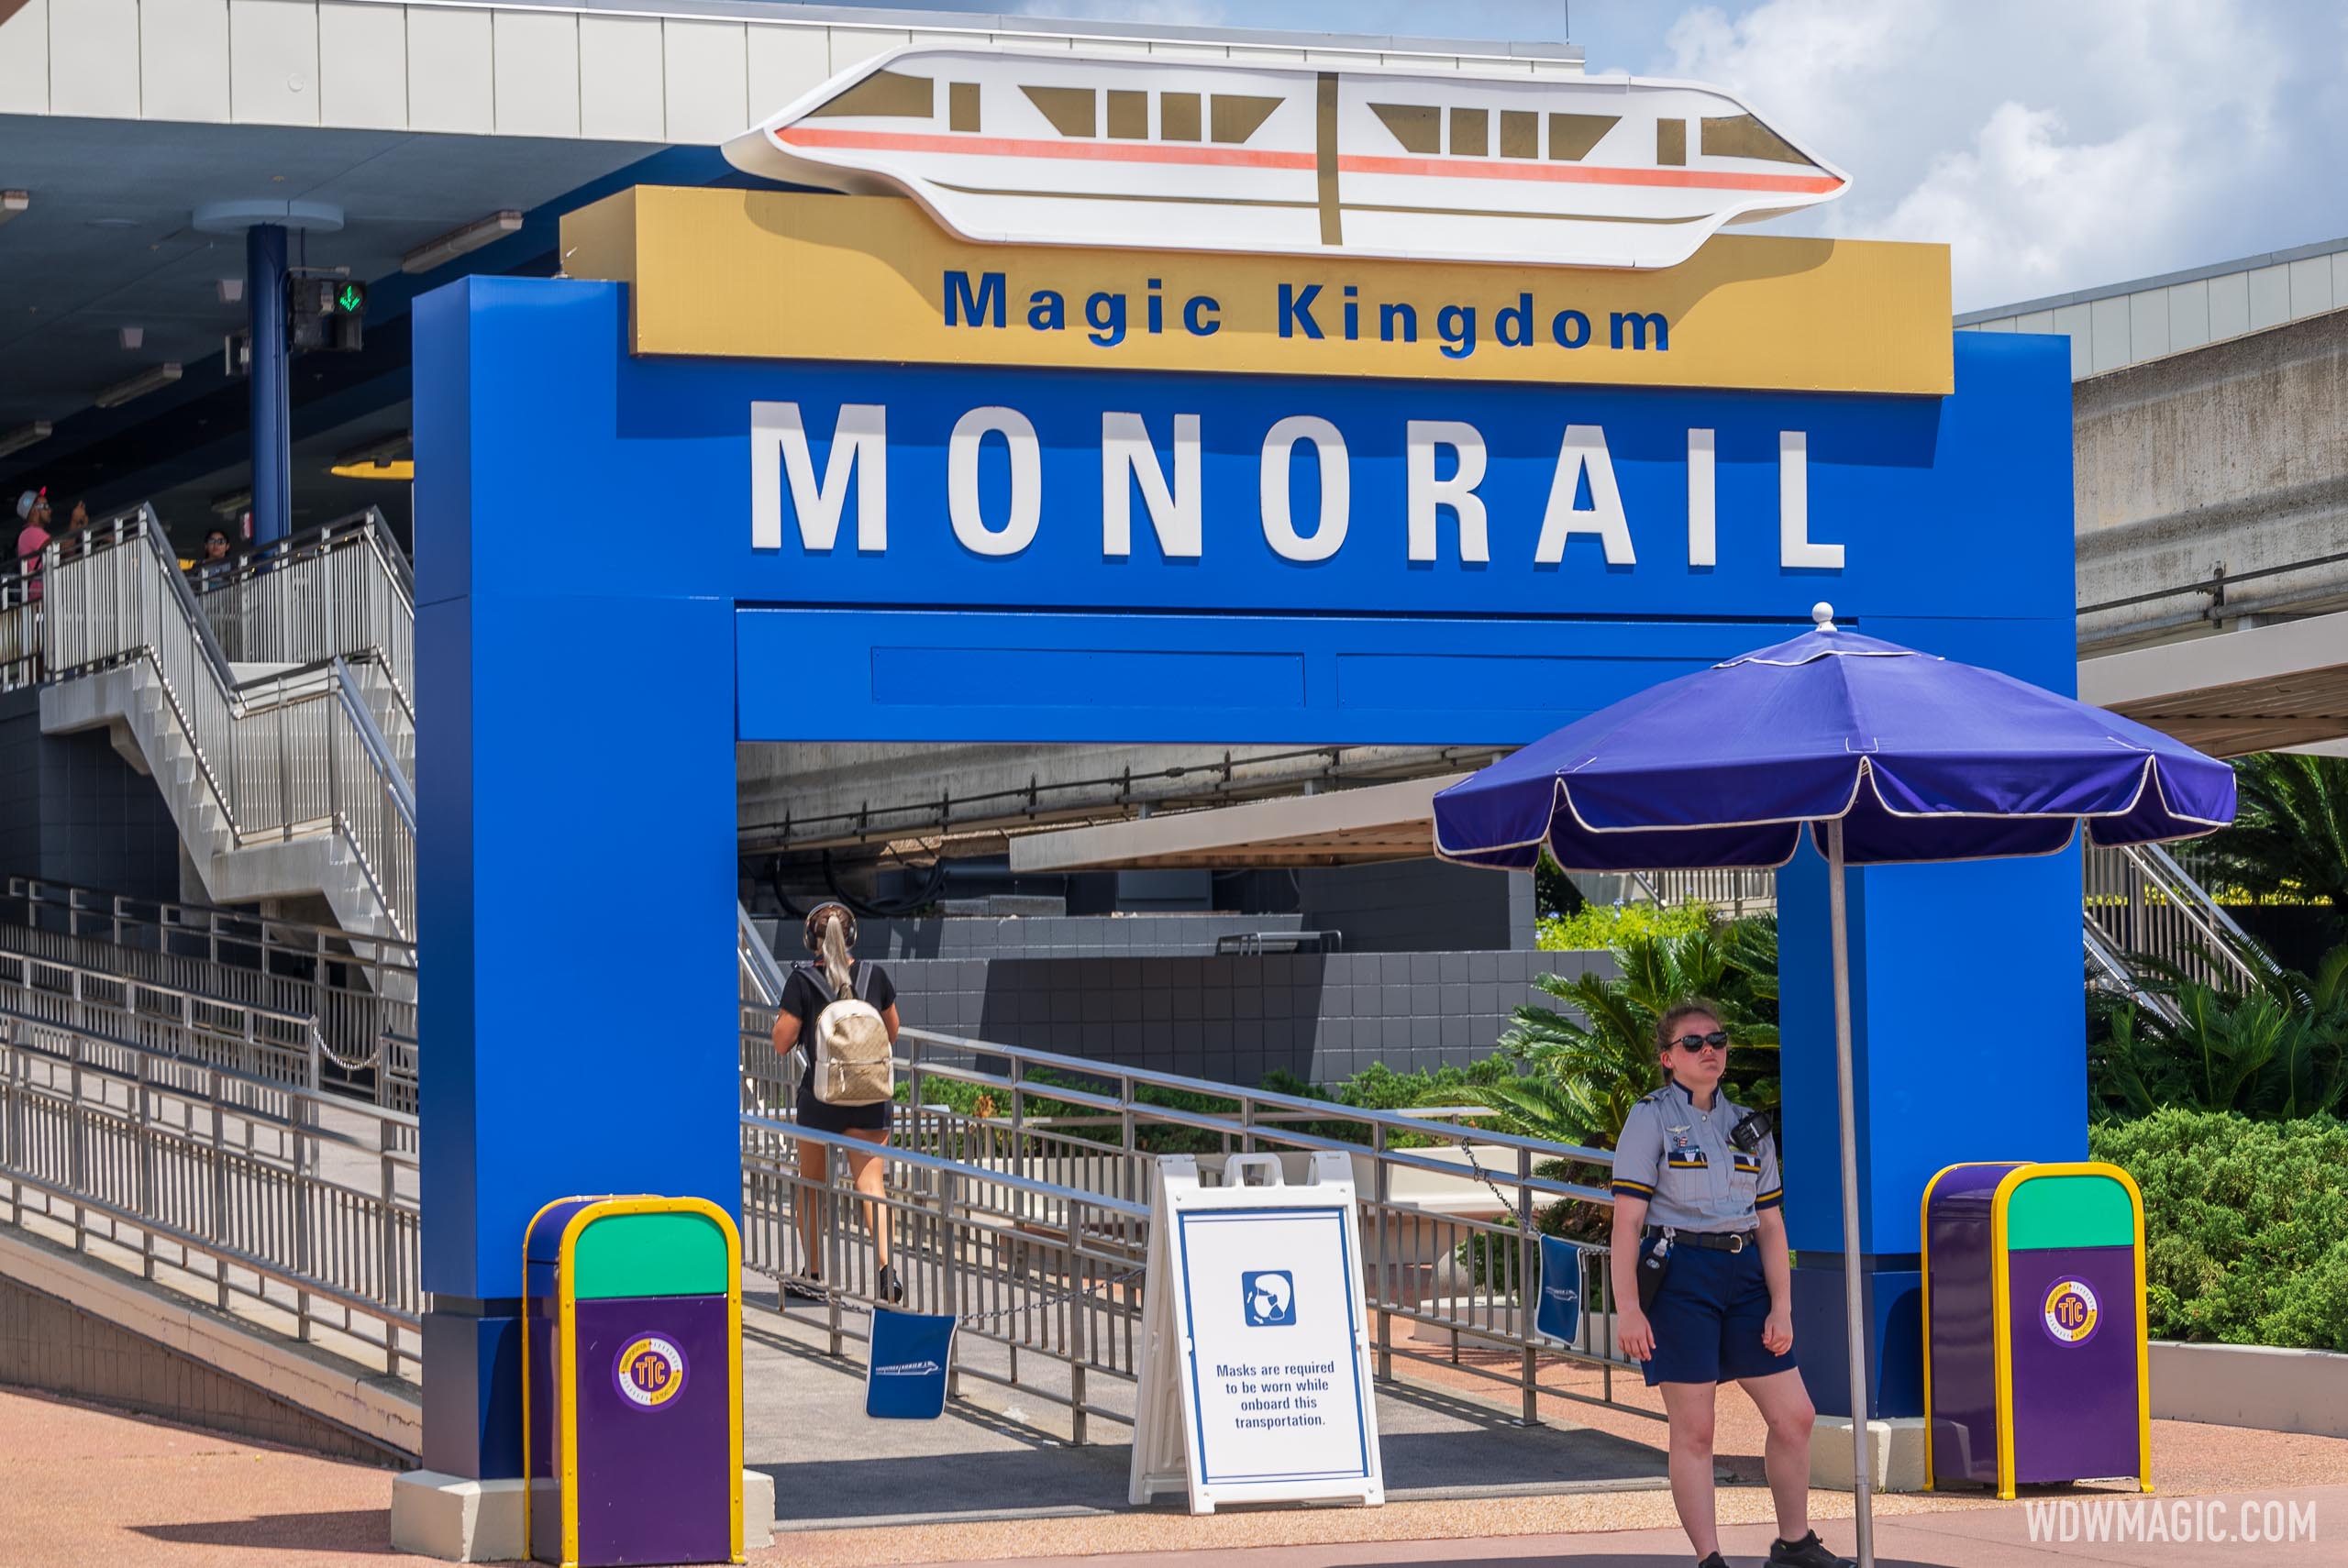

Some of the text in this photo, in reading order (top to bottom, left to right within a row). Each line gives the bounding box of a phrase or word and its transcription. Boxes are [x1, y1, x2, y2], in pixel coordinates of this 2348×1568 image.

[942, 270, 1671, 359] Magic Kingdom
[750, 401, 1845, 569] MONORAIL
[2059, 1297, 2083, 1326] TTC
[636, 1356, 665, 1388] TTC
[1216, 1361, 1335, 1377] Masks are required
[1225, 1378, 1329, 1394] to be worn while
[1241, 1396, 1317, 1411] onboard this
[1235, 1413, 1325, 1430] transportation.
